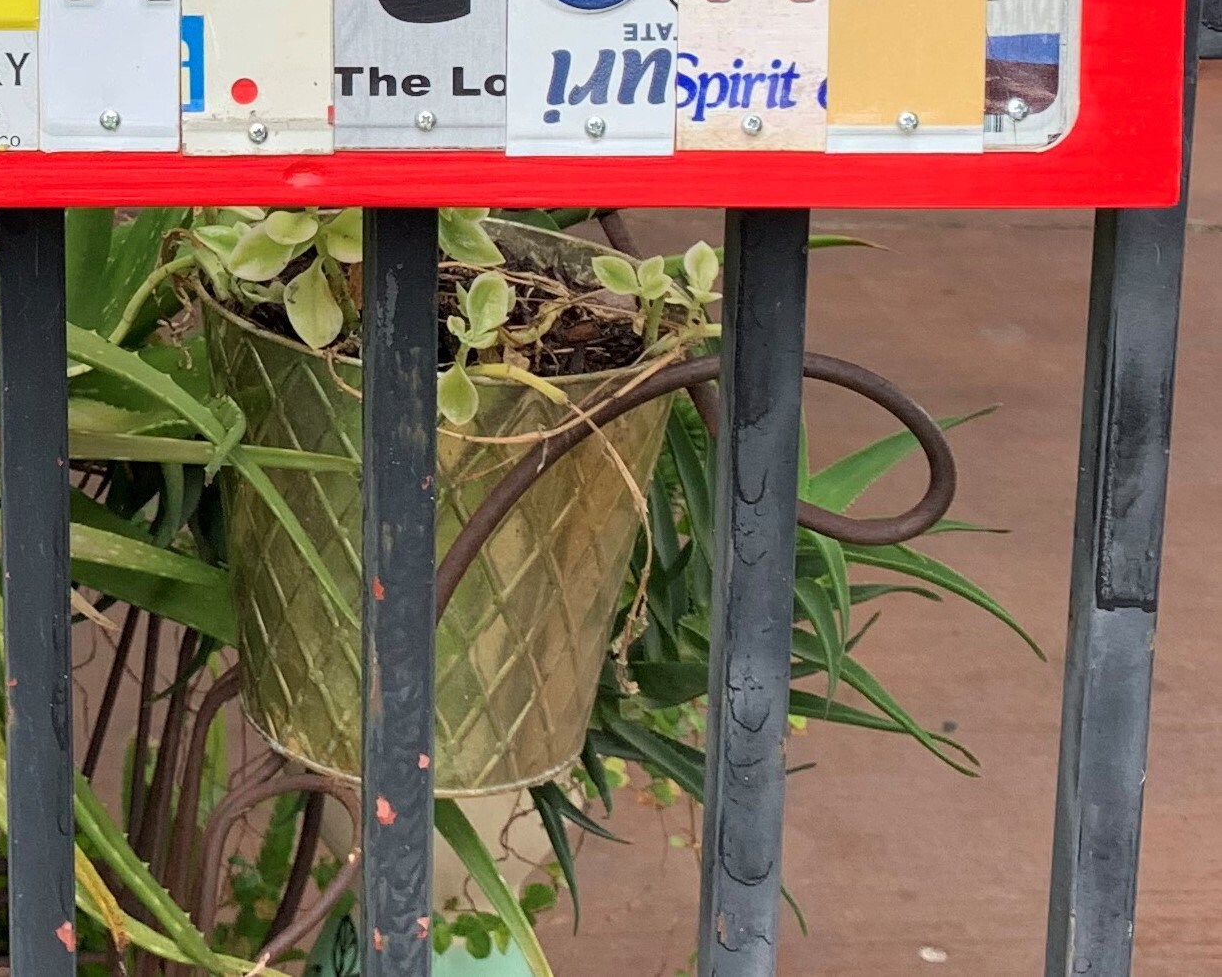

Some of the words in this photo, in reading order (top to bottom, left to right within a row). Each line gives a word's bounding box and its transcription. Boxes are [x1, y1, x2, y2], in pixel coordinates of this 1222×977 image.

[623, 22, 677, 42] ATE
[334, 66, 431, 97] The
[452, 66, 507, 97] Lo
[675, 52, 800, 122] Spirit
